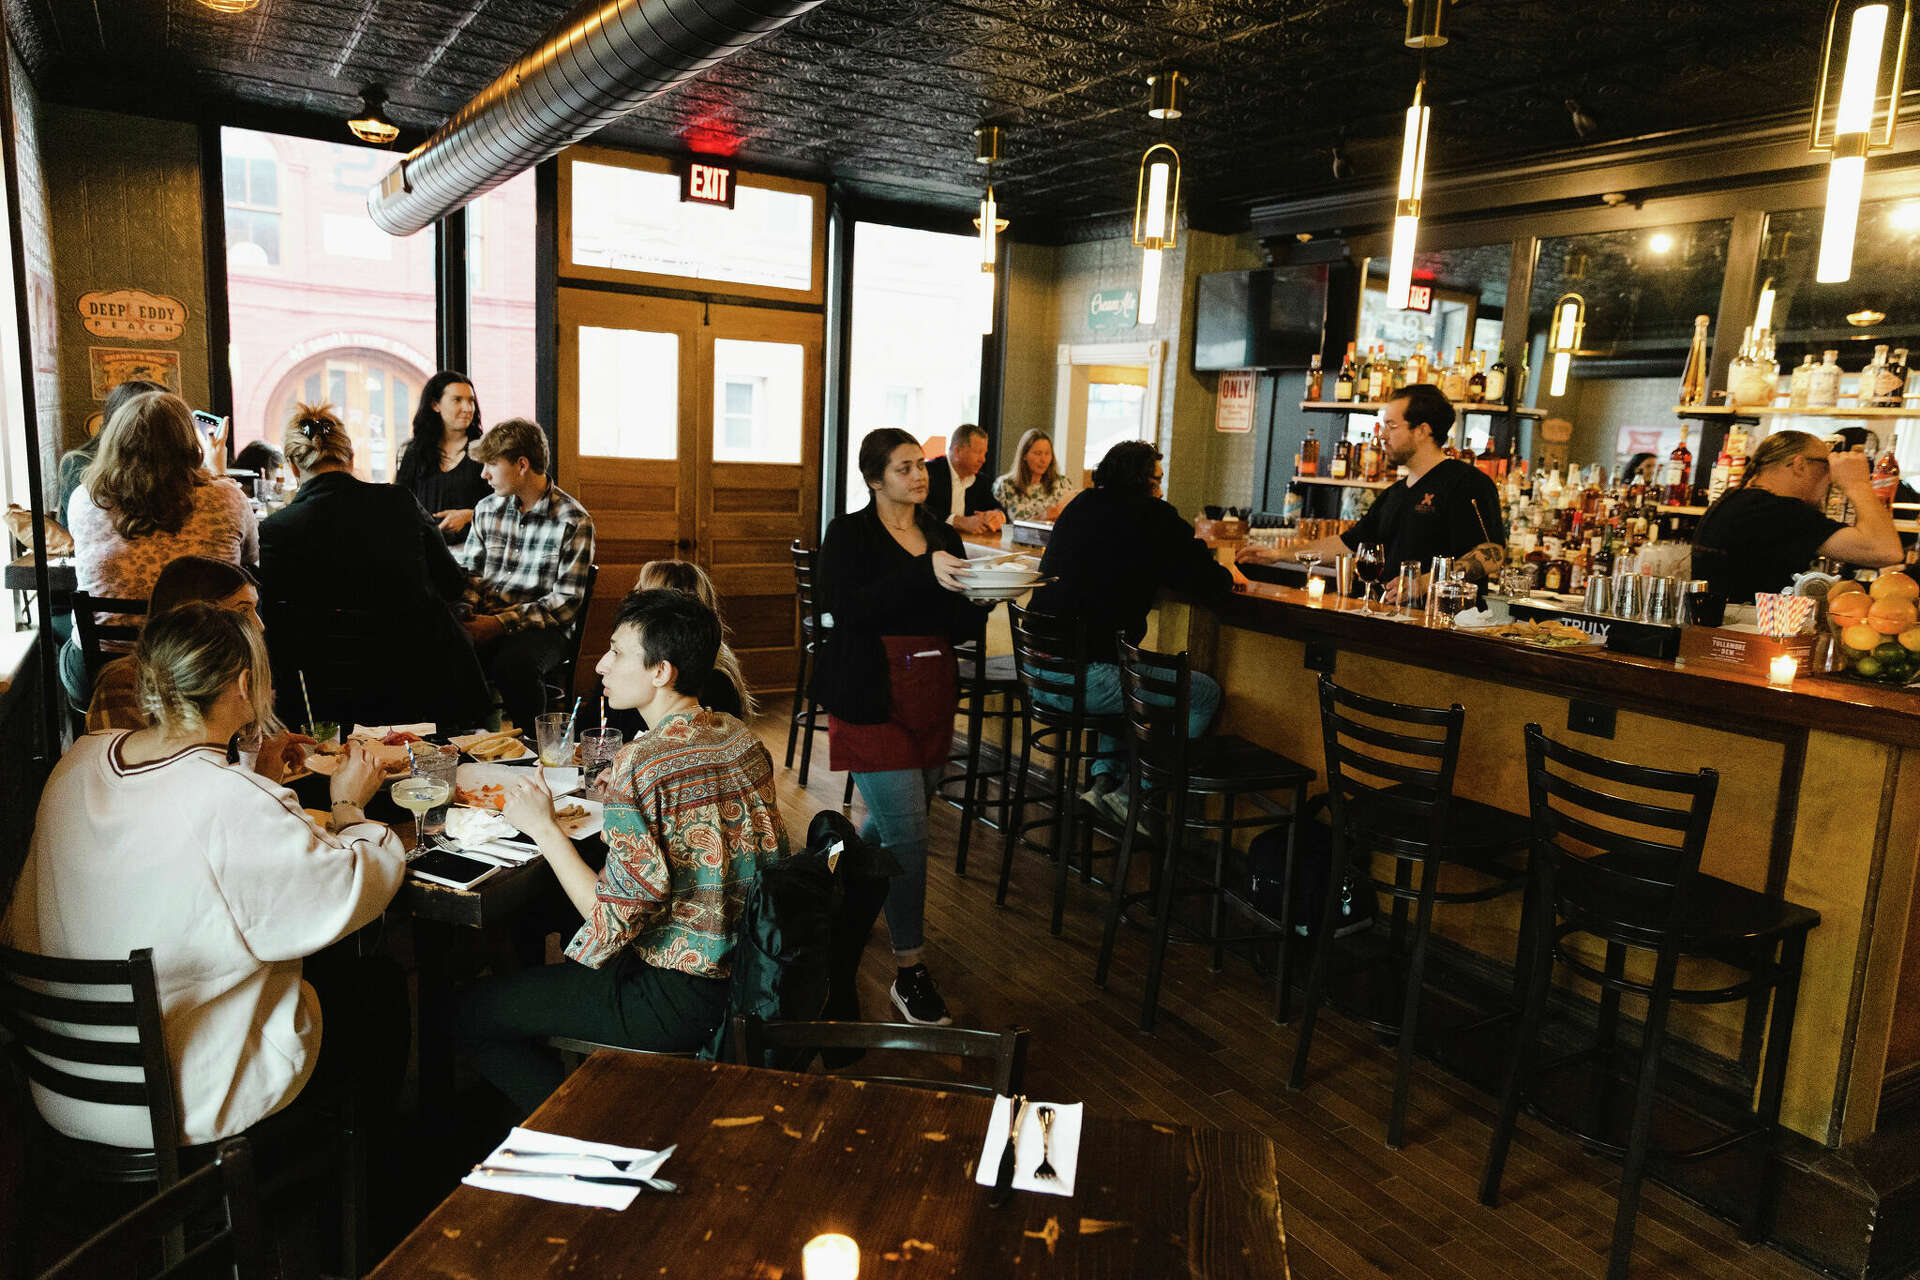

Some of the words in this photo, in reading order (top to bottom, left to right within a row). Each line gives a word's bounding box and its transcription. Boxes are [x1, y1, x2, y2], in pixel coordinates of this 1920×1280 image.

[691, 163, 730, 202] EXIT
[89, 302, 126, 317] DEEP
[139, 305, 175, 321] EDDY
[94, 320, 173, 333] PEACH
[1223, 380, 1250, 399] ONLY
[1561, 617, 1611, 637] TRULY
